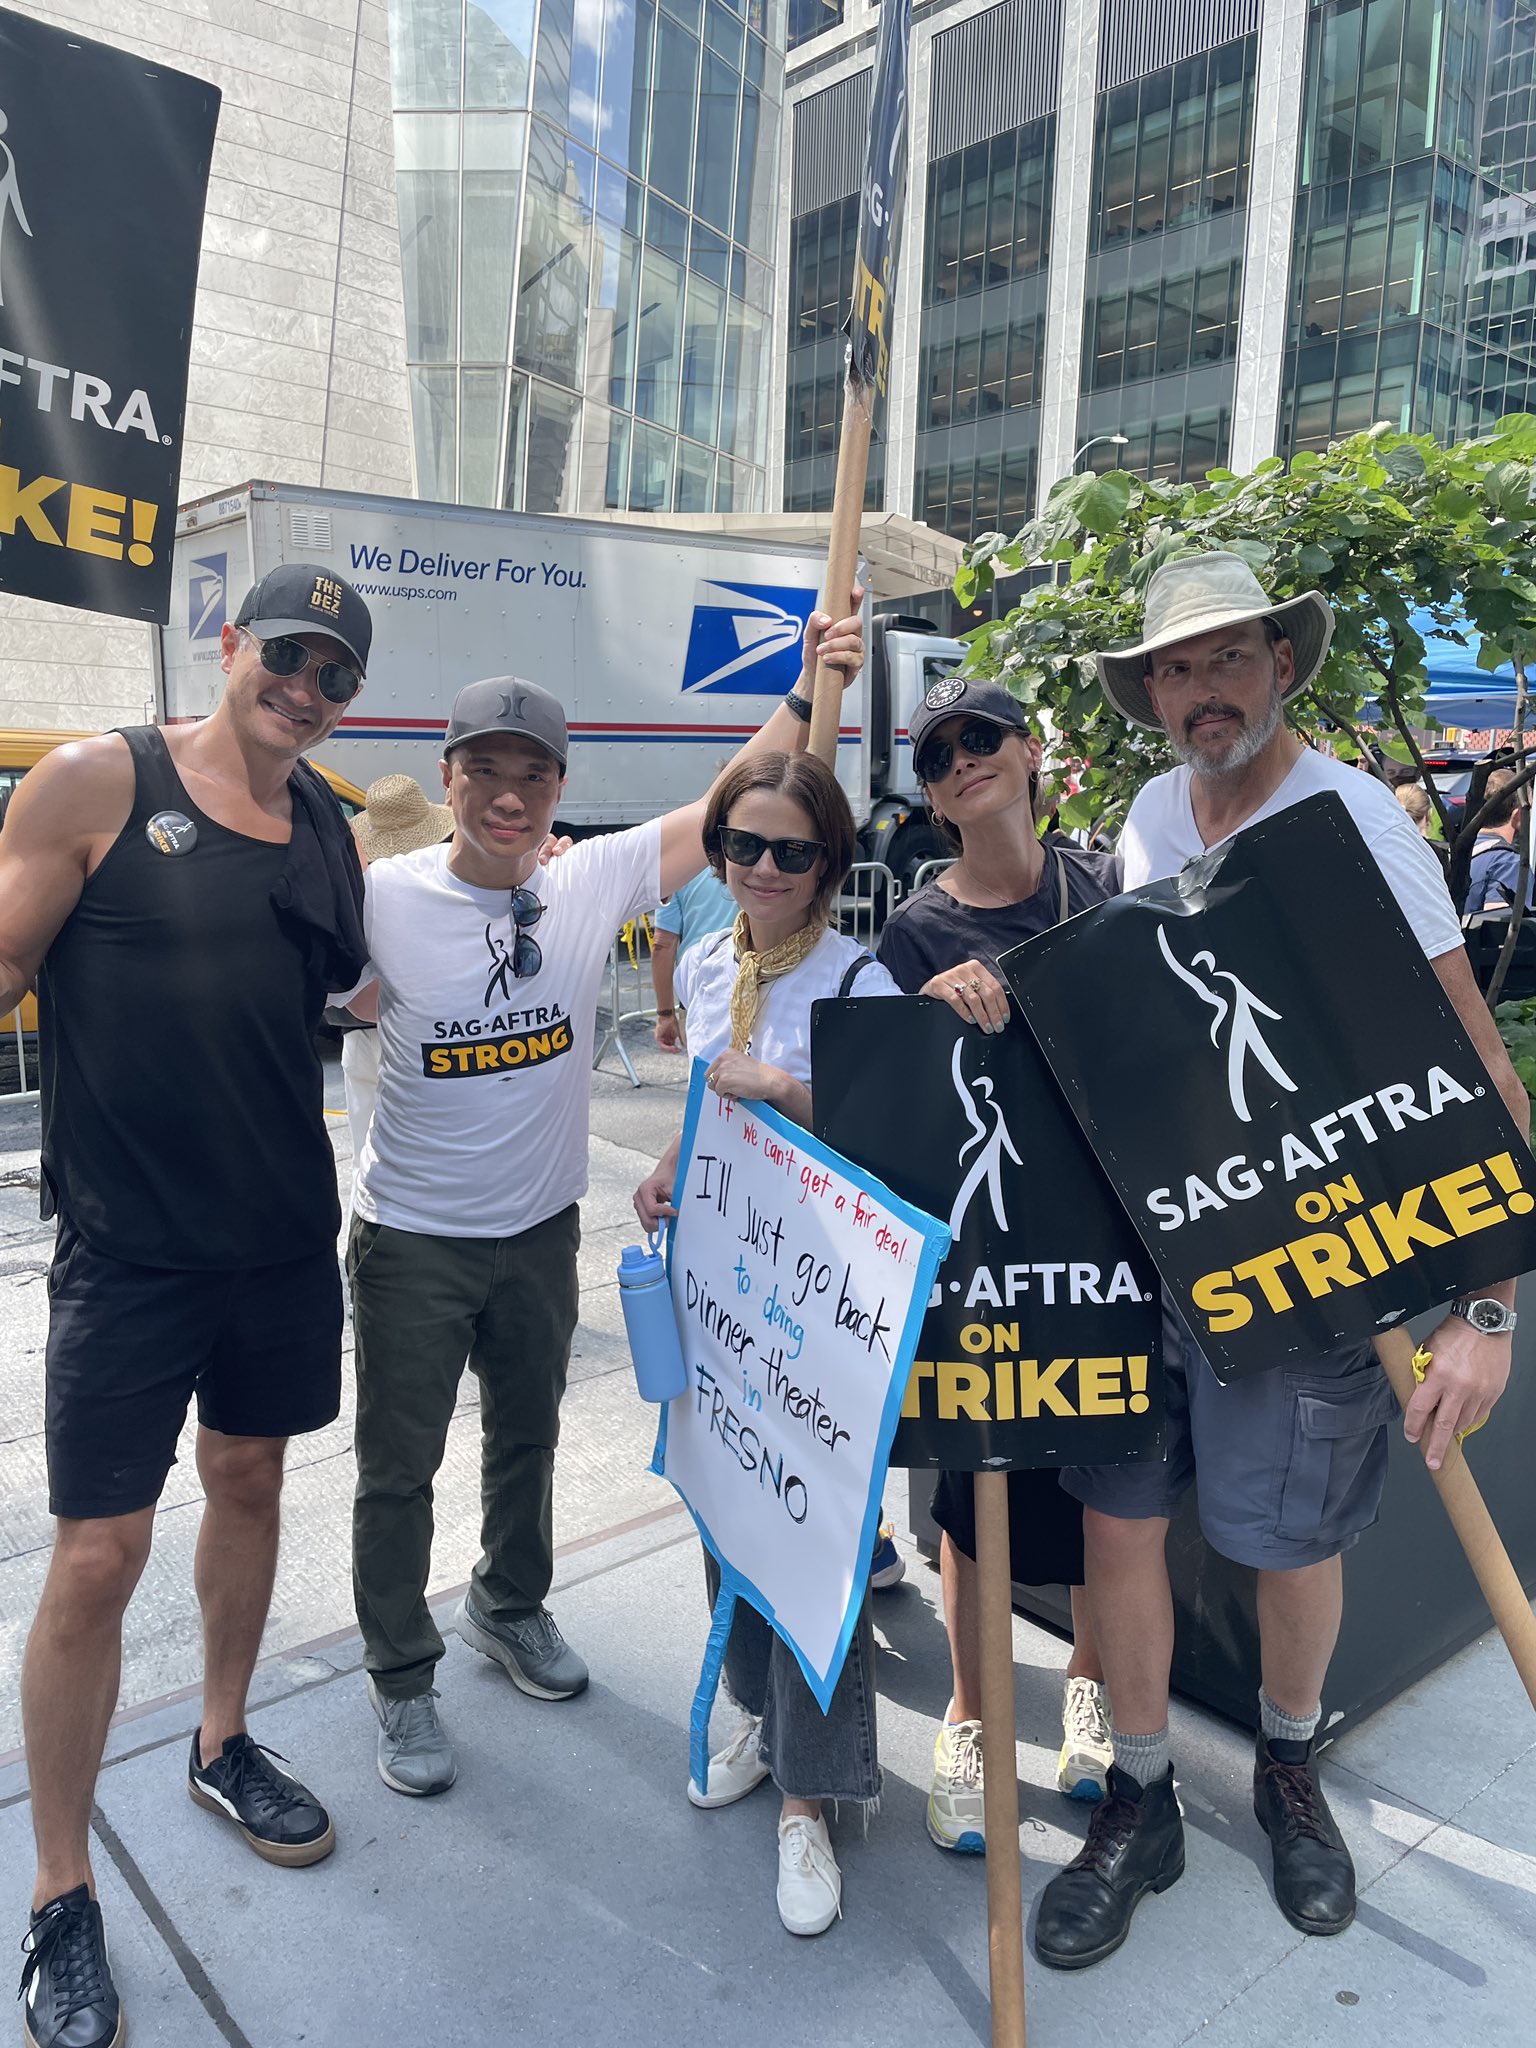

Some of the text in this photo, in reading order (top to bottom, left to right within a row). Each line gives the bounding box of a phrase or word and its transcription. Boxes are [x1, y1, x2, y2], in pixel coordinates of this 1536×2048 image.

[0, 463, 159, 567] KE!
[315, 576, 342, 600] THE
[350, 544, 587, 588] We Deliver For You.
[352, 582, 458, 601] www.usps.com
[311, 591, 341, 614] DEZ
[430, 1025, 568, 1073] STRONG
[718, 1096, 737, 1122] If
[764, 1137, 797, 1176] can't
[798, 1166, 833, 1204] get
[835, 1194, 847, 1213] a
[852, 1191, 878, 1230] fair
[1295, 1173, 1365, 1224] ON
[696, 1155, 732, 1217] I'll
[792, 1253, 832, 1306] go
[835, 1263, 891, 1364] back
[1191, 1151, 1535, 1333] STRIKE!
[733, 1254, 804, 1360] to doing
[686, 1268, 851, 1452] Dinner theater
[959, 1322, 1020, 1354] ON
[742, 1370, 762, 1412] in
[901, 1355, 1150, 1421] TRIKE!
[696, 1363, 808, 1524] FRESNO
